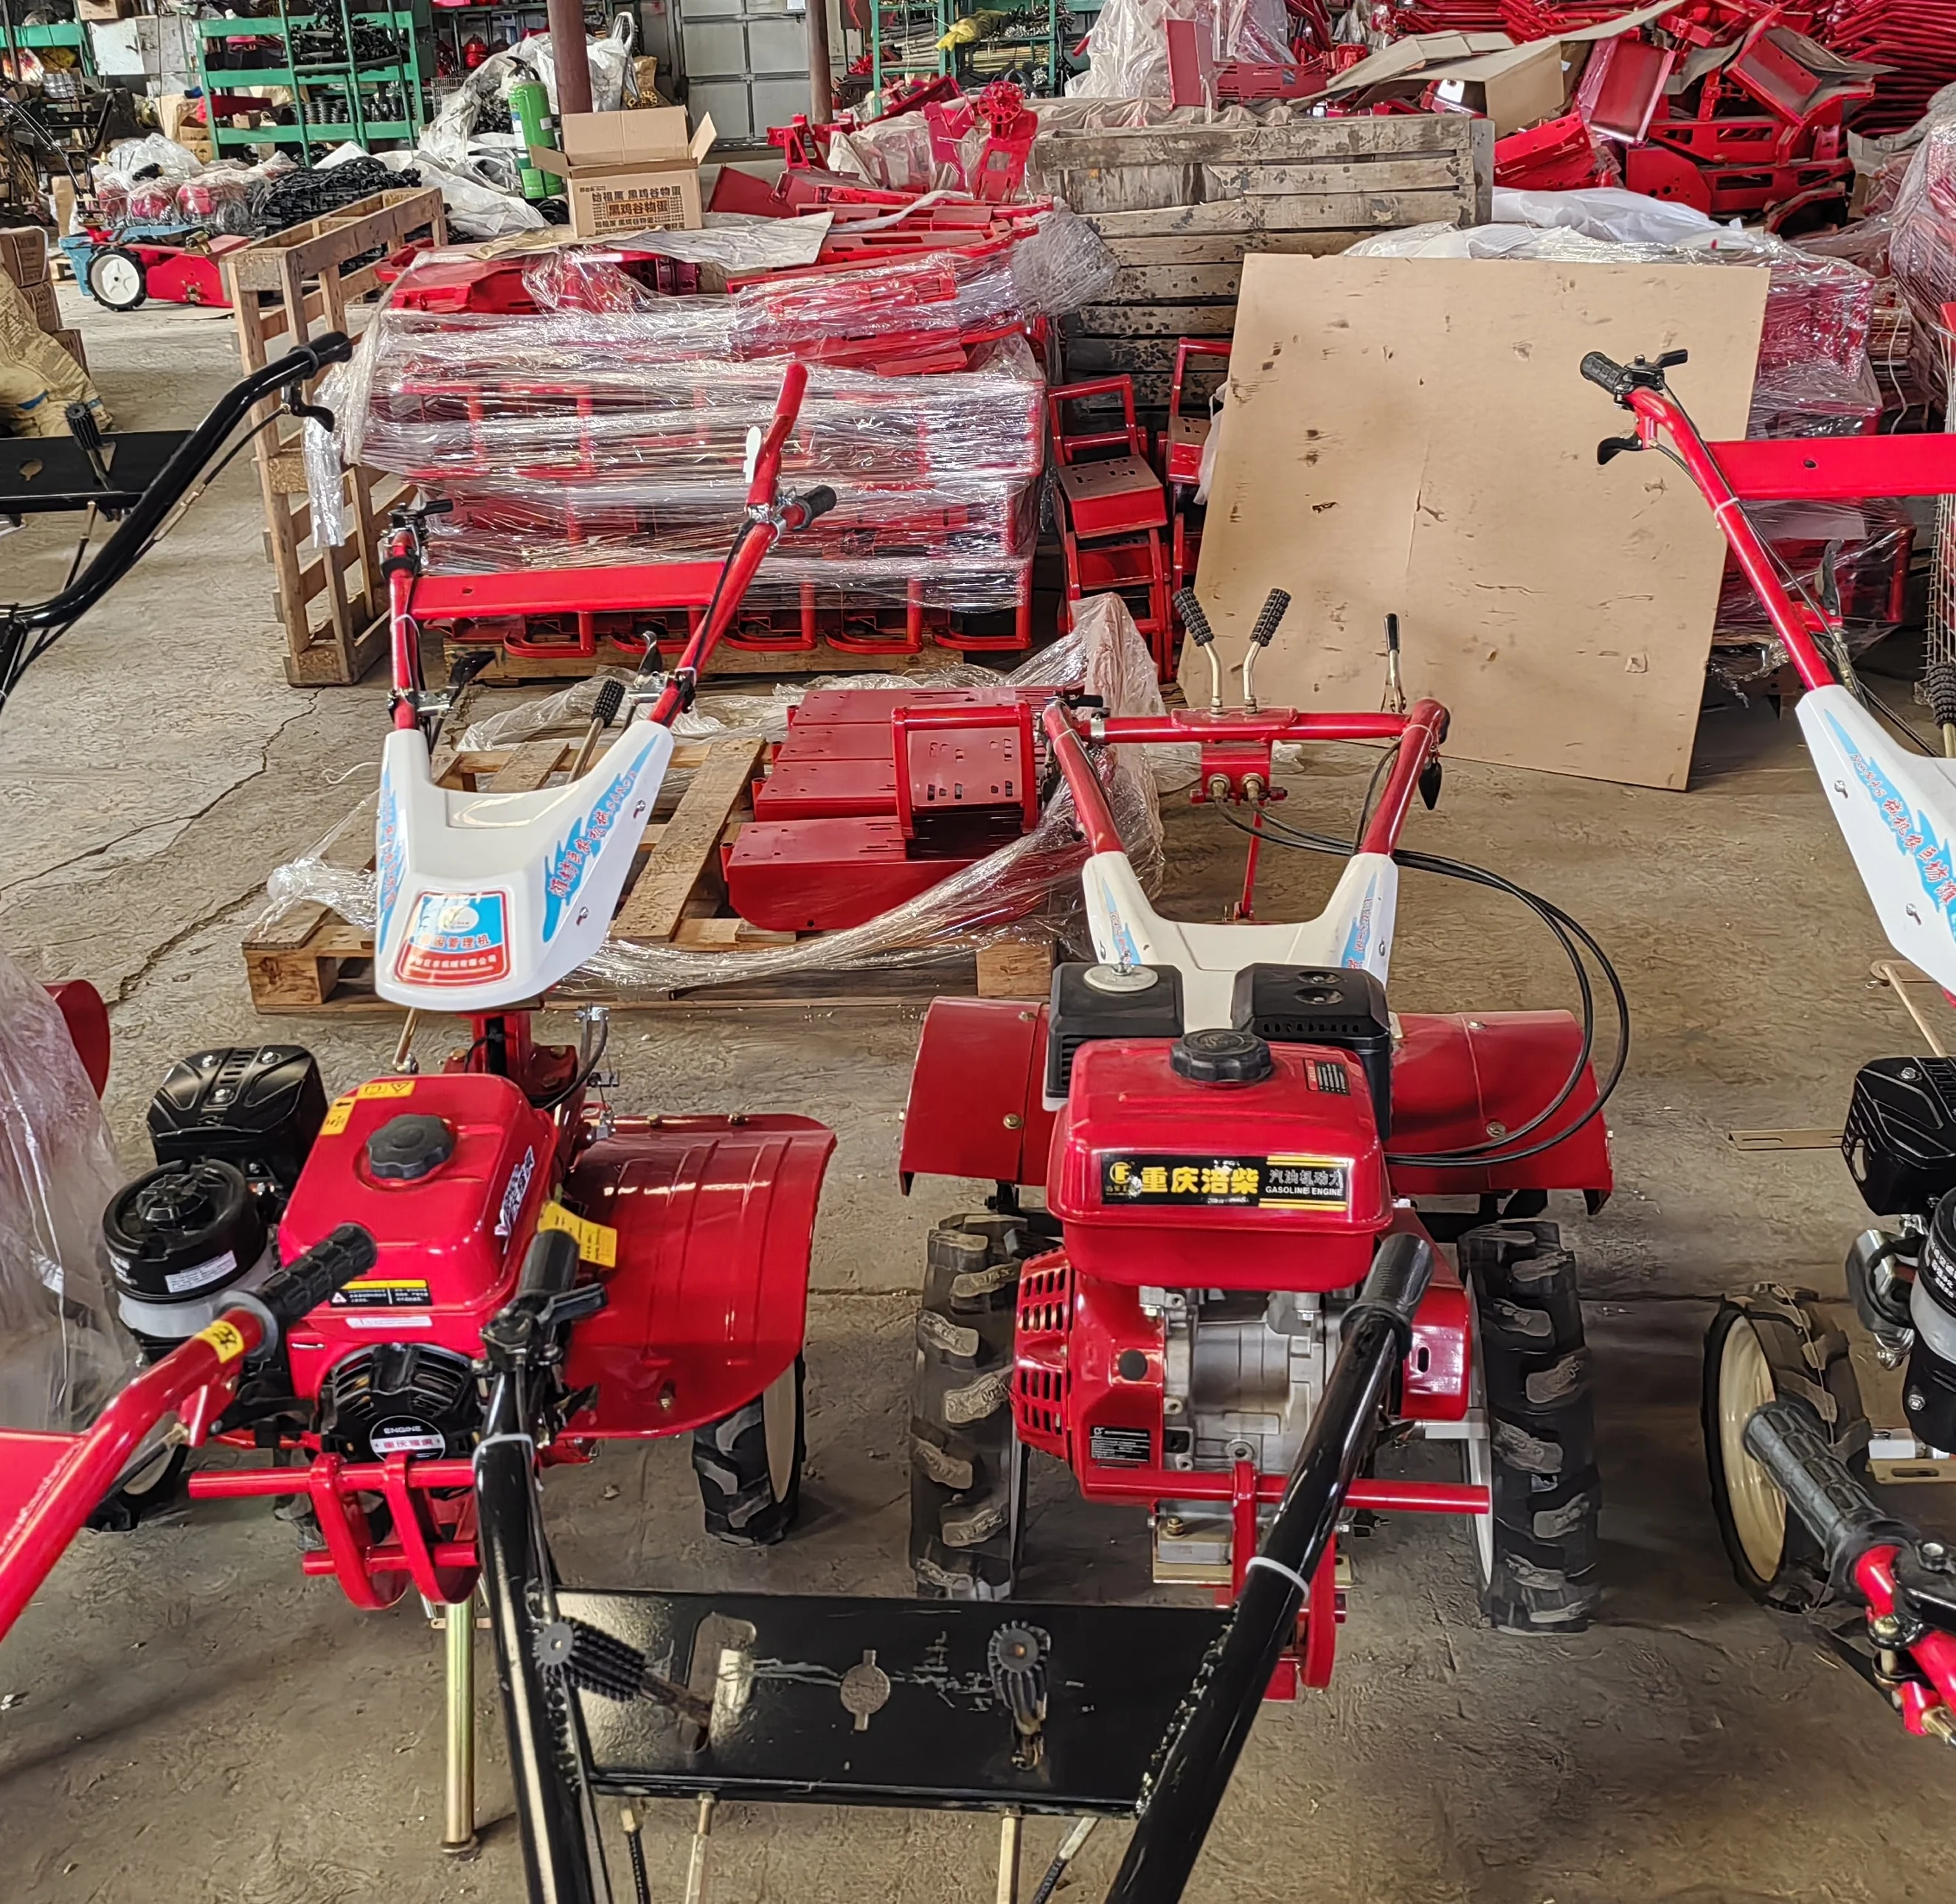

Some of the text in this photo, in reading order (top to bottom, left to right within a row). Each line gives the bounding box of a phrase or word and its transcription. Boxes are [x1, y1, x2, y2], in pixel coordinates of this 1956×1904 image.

[628, 185, 682, 200] 黑鸡谷物蛋
[608, 199, 670, 217] 黑鸡谷物蛋
[1269, 1168, 1344, 1187] 汽油机动力
[1265, 1185, 1343, 1196] GASOLINE ENGINE
